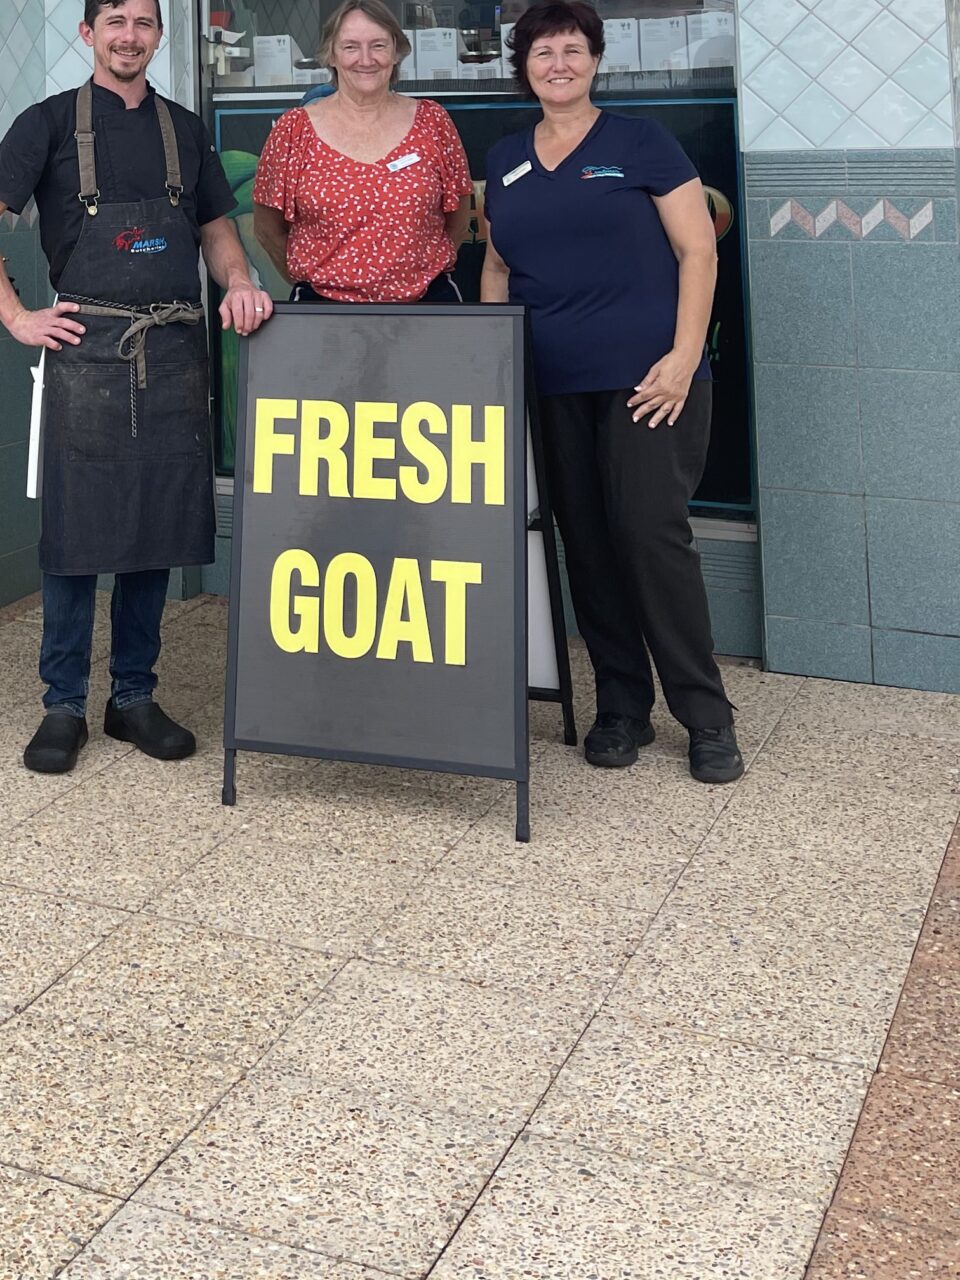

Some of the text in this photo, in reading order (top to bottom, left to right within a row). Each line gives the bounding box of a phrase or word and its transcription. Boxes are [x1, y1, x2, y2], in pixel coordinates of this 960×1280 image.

[132, 236, 165, 249] MARSH
[253, 398, 505, 505] FRESH
[269, 549, 482, 666] GOAT
